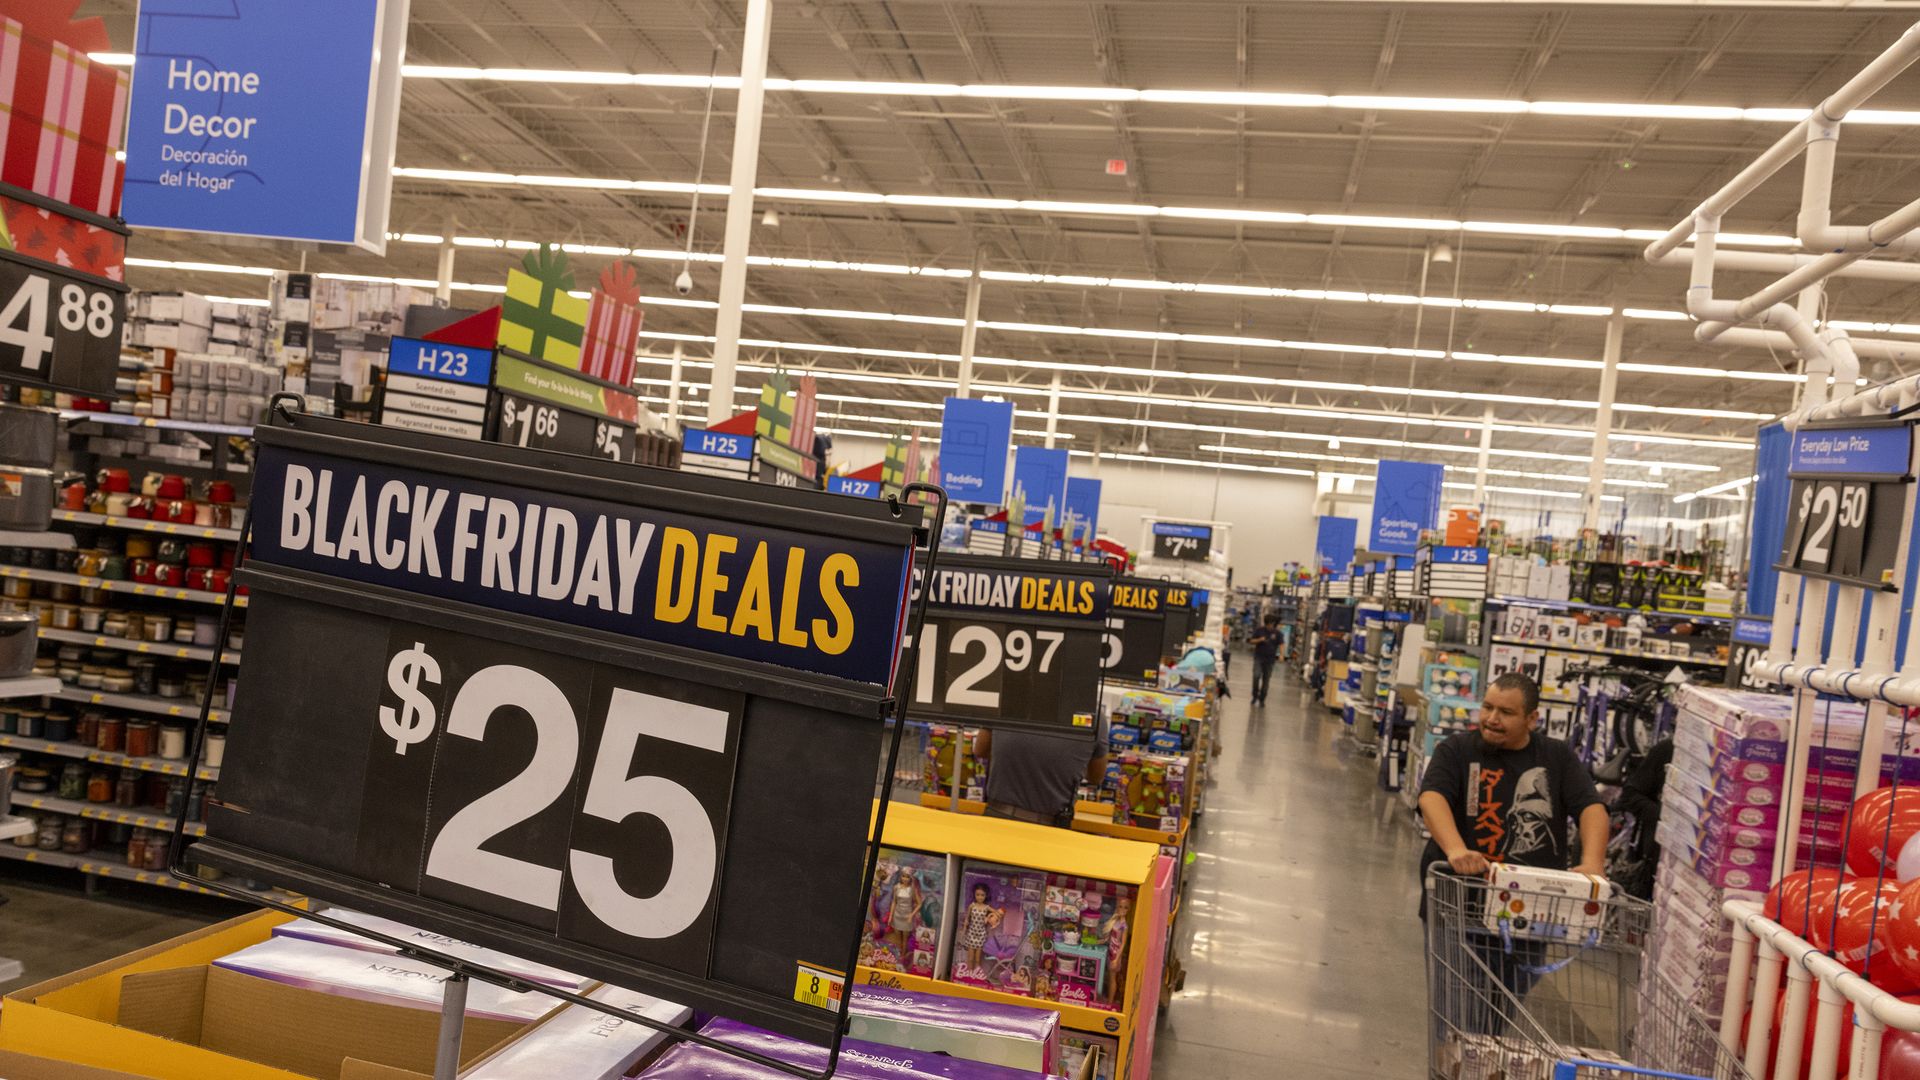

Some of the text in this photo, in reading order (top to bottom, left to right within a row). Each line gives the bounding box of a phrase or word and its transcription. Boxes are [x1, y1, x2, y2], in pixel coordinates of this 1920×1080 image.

[168, 59, 260, 94] Home
[164, 104, 257, 138] Decor
[161, 145, 248, 167] Decoración
[159, 171, 235, 193] del Hogar
[416, 382, 443, 395] Scented
[409, 400, 458, 415] Votive candles
[395, 416, 433, 429] Fragranced
[1800, 436, 1870, 456] Everyday Low Price
[946, 472, 983, 488] Bedding
[1380, 517, 1418, 531] Sporting
[1379, 529, 1408, 539] Goods
[280, 464, 860, 655] BLACK FRIDAY DEALS
[940, 571, 1020, 608] FRIDAY
[1021, 577, 1095, 615] DEALS
[1113, 584, 1159, 610] DEALS
[1166, 589, 1188, 606] ALS
[378, 642, 729, 940] $25
[872, 949, 897, 964] Barbie
[367, 963, 447, 984] FROZEN
[868, 972, 904, 989] Barbie
[956, 963, 987, 980] Barbie
[810, 976, 820, 994] 8
[1061, 984, 1087, 1000] Barbie
[591, 1003, 644, 1037] FRON
